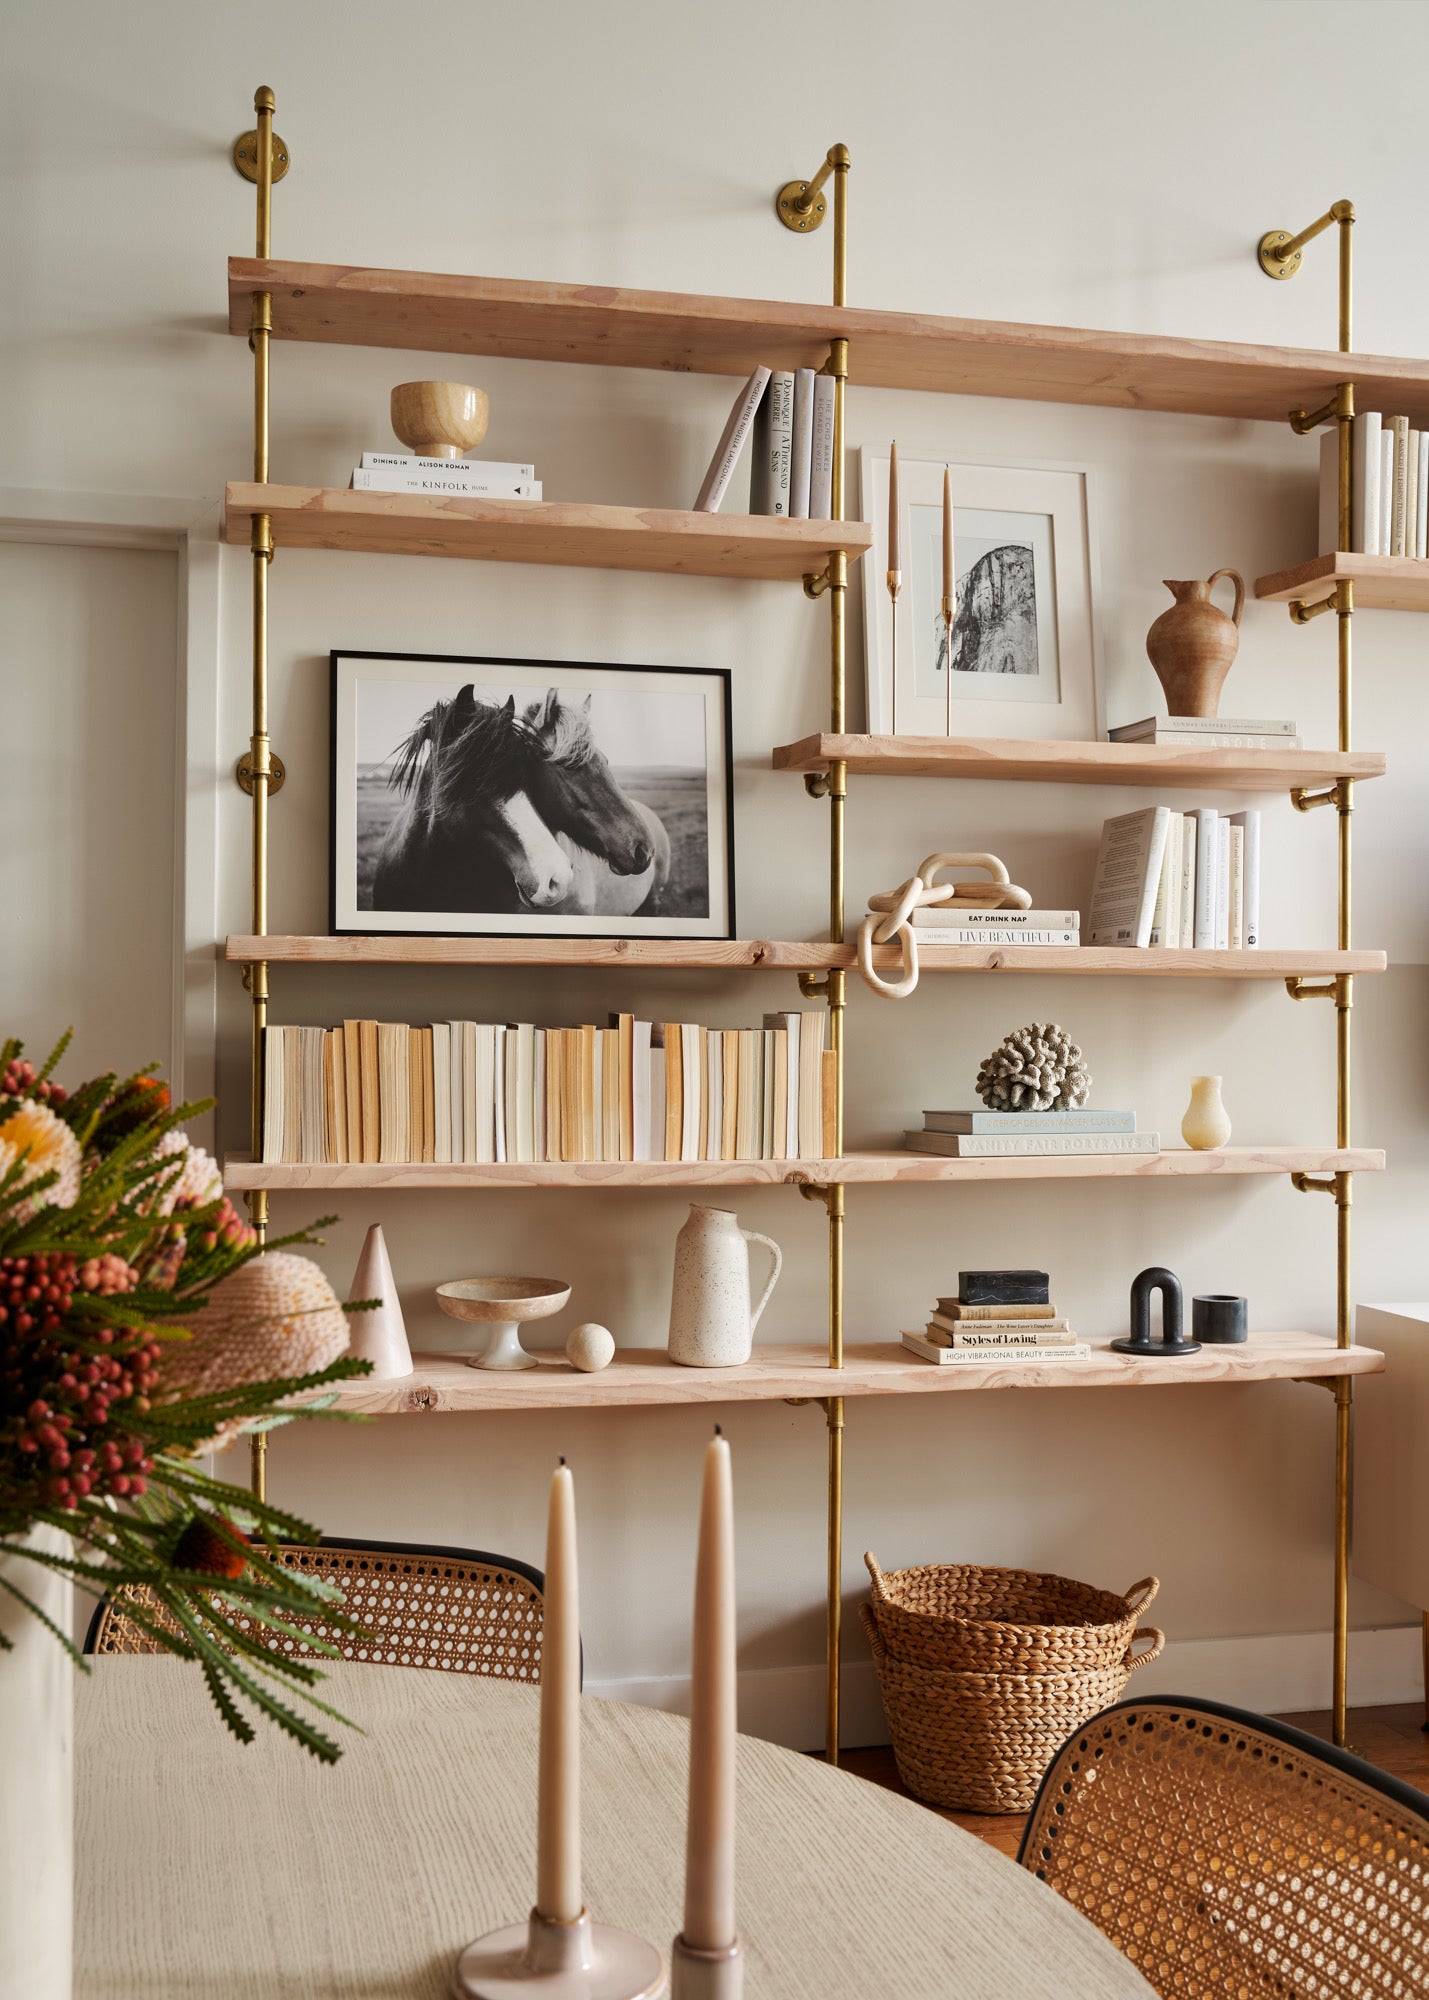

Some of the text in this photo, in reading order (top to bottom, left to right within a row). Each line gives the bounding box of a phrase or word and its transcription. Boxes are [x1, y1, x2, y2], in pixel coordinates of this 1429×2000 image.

[772, 382, 783, 422] LAPIERRE
[782, 380, 793, 426] DOMINIQUE
[720, 380, 762, 480] NIGELLA BITES NIGELLA LAWSON
[771, 450, 780, 472] SUNS
[780, 444, 791, 489] THOUSAND
[422, 481, 468, 491] KINFOLK
[959, 931, 986, 942] LIVE
[989, 932, 1055, 943] BEAUTIFUL
[986, 1119, 1022, 1128] INTERIOR
[1024, 1119, 1053, 1128] DESIGN
[1056, 1118, 1088, 1127] MASTER
[966, 1136, 1142, 1152] VANITY FAIR PORTRAITS
[962, 1335, 992, 1346] Styles
[993, 1335, 1002, 1344] of
[1004, 1334, 1037, 1345] Loving
